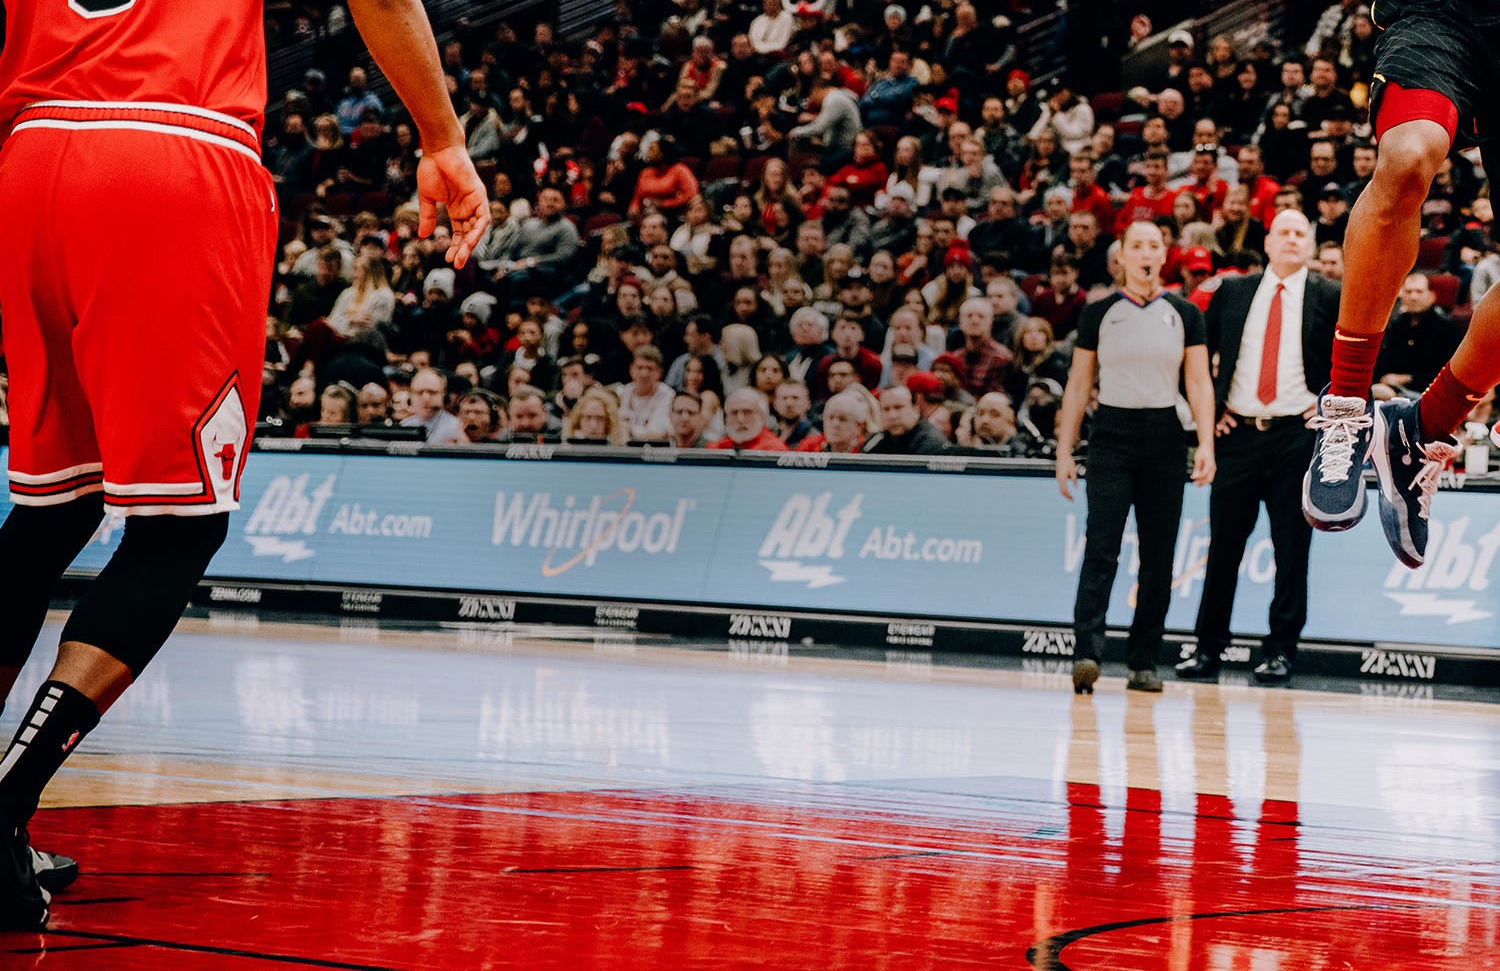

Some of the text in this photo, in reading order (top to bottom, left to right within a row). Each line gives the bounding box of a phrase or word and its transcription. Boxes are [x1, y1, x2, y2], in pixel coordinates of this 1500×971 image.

[244, 473, 433, 538] Abt Abt.com
[492, 490, 688, 567] Whirlpool
[758, 491, 984, 564] Abt Abt.com
